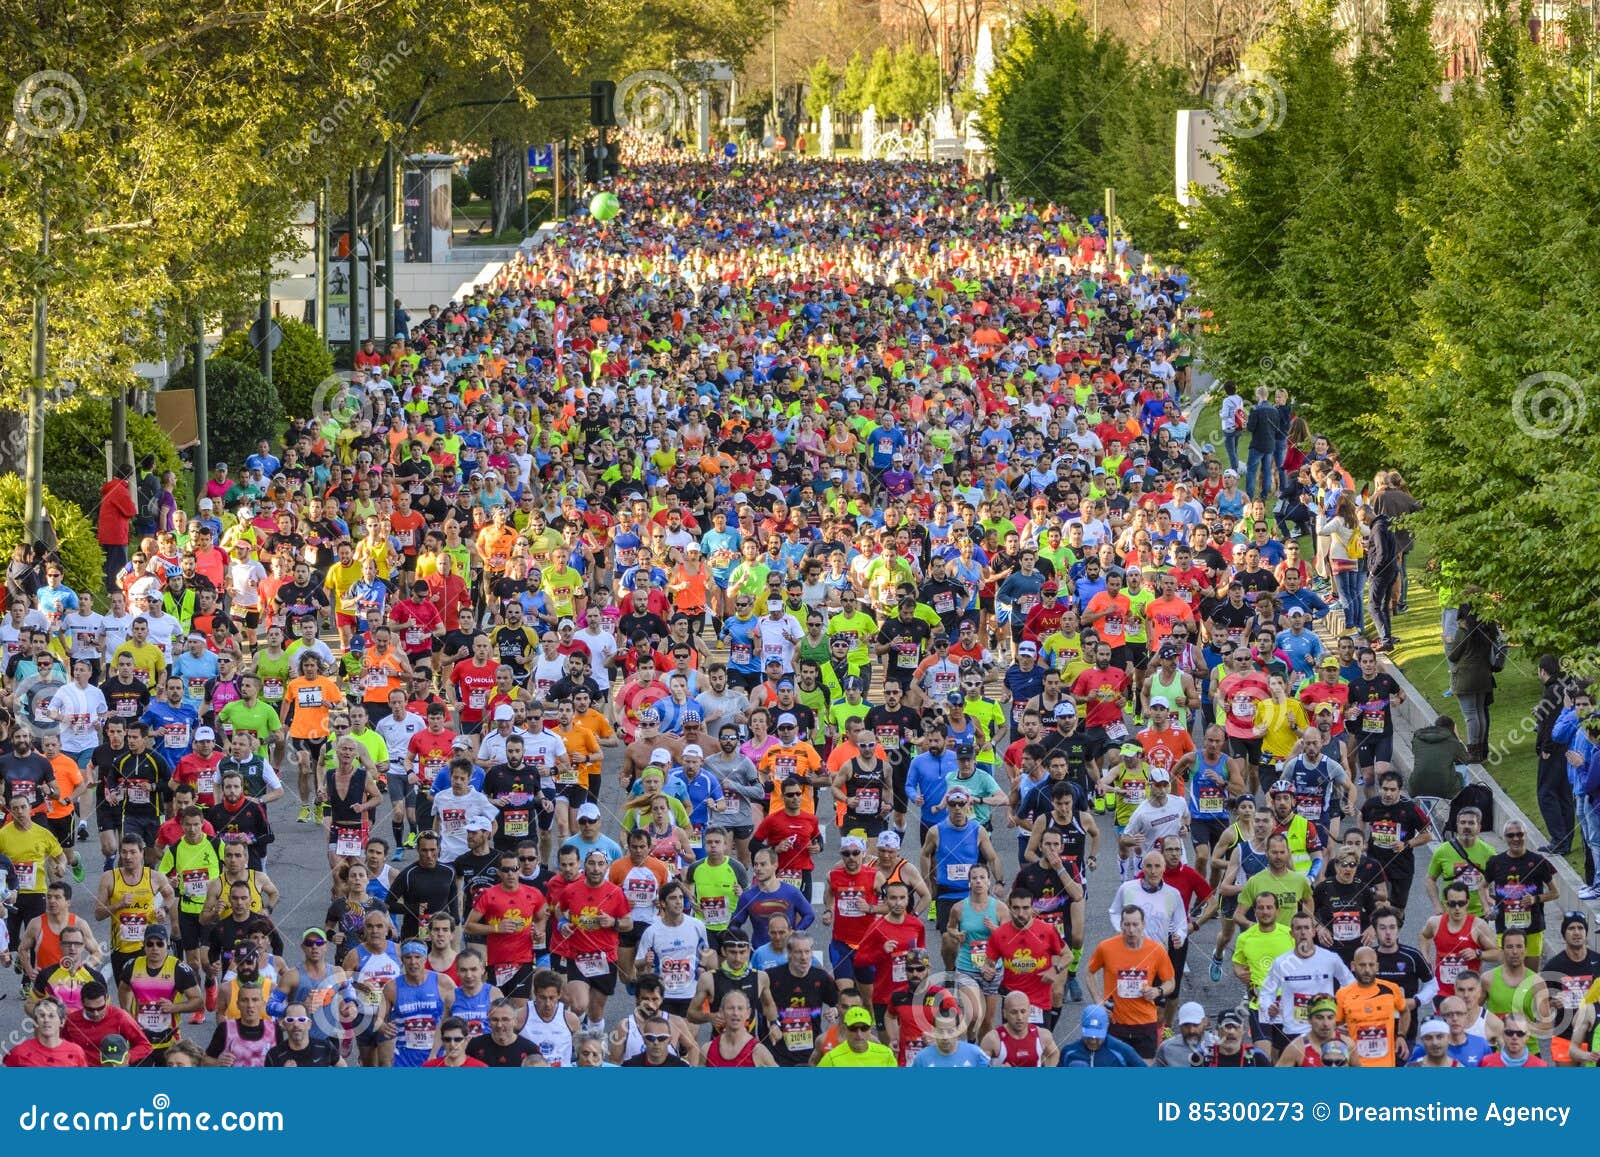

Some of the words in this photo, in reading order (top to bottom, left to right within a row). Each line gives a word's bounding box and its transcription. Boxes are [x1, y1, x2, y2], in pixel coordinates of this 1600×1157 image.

[534, 147, 547, 166] P
[512, 784, 524, 792] 21
[504, 908, 521, 920] 42
[581, 905, 598, 917] 42
[1013, 949, 1032, 959] 42
[791, 997, 805, 1007] 21
